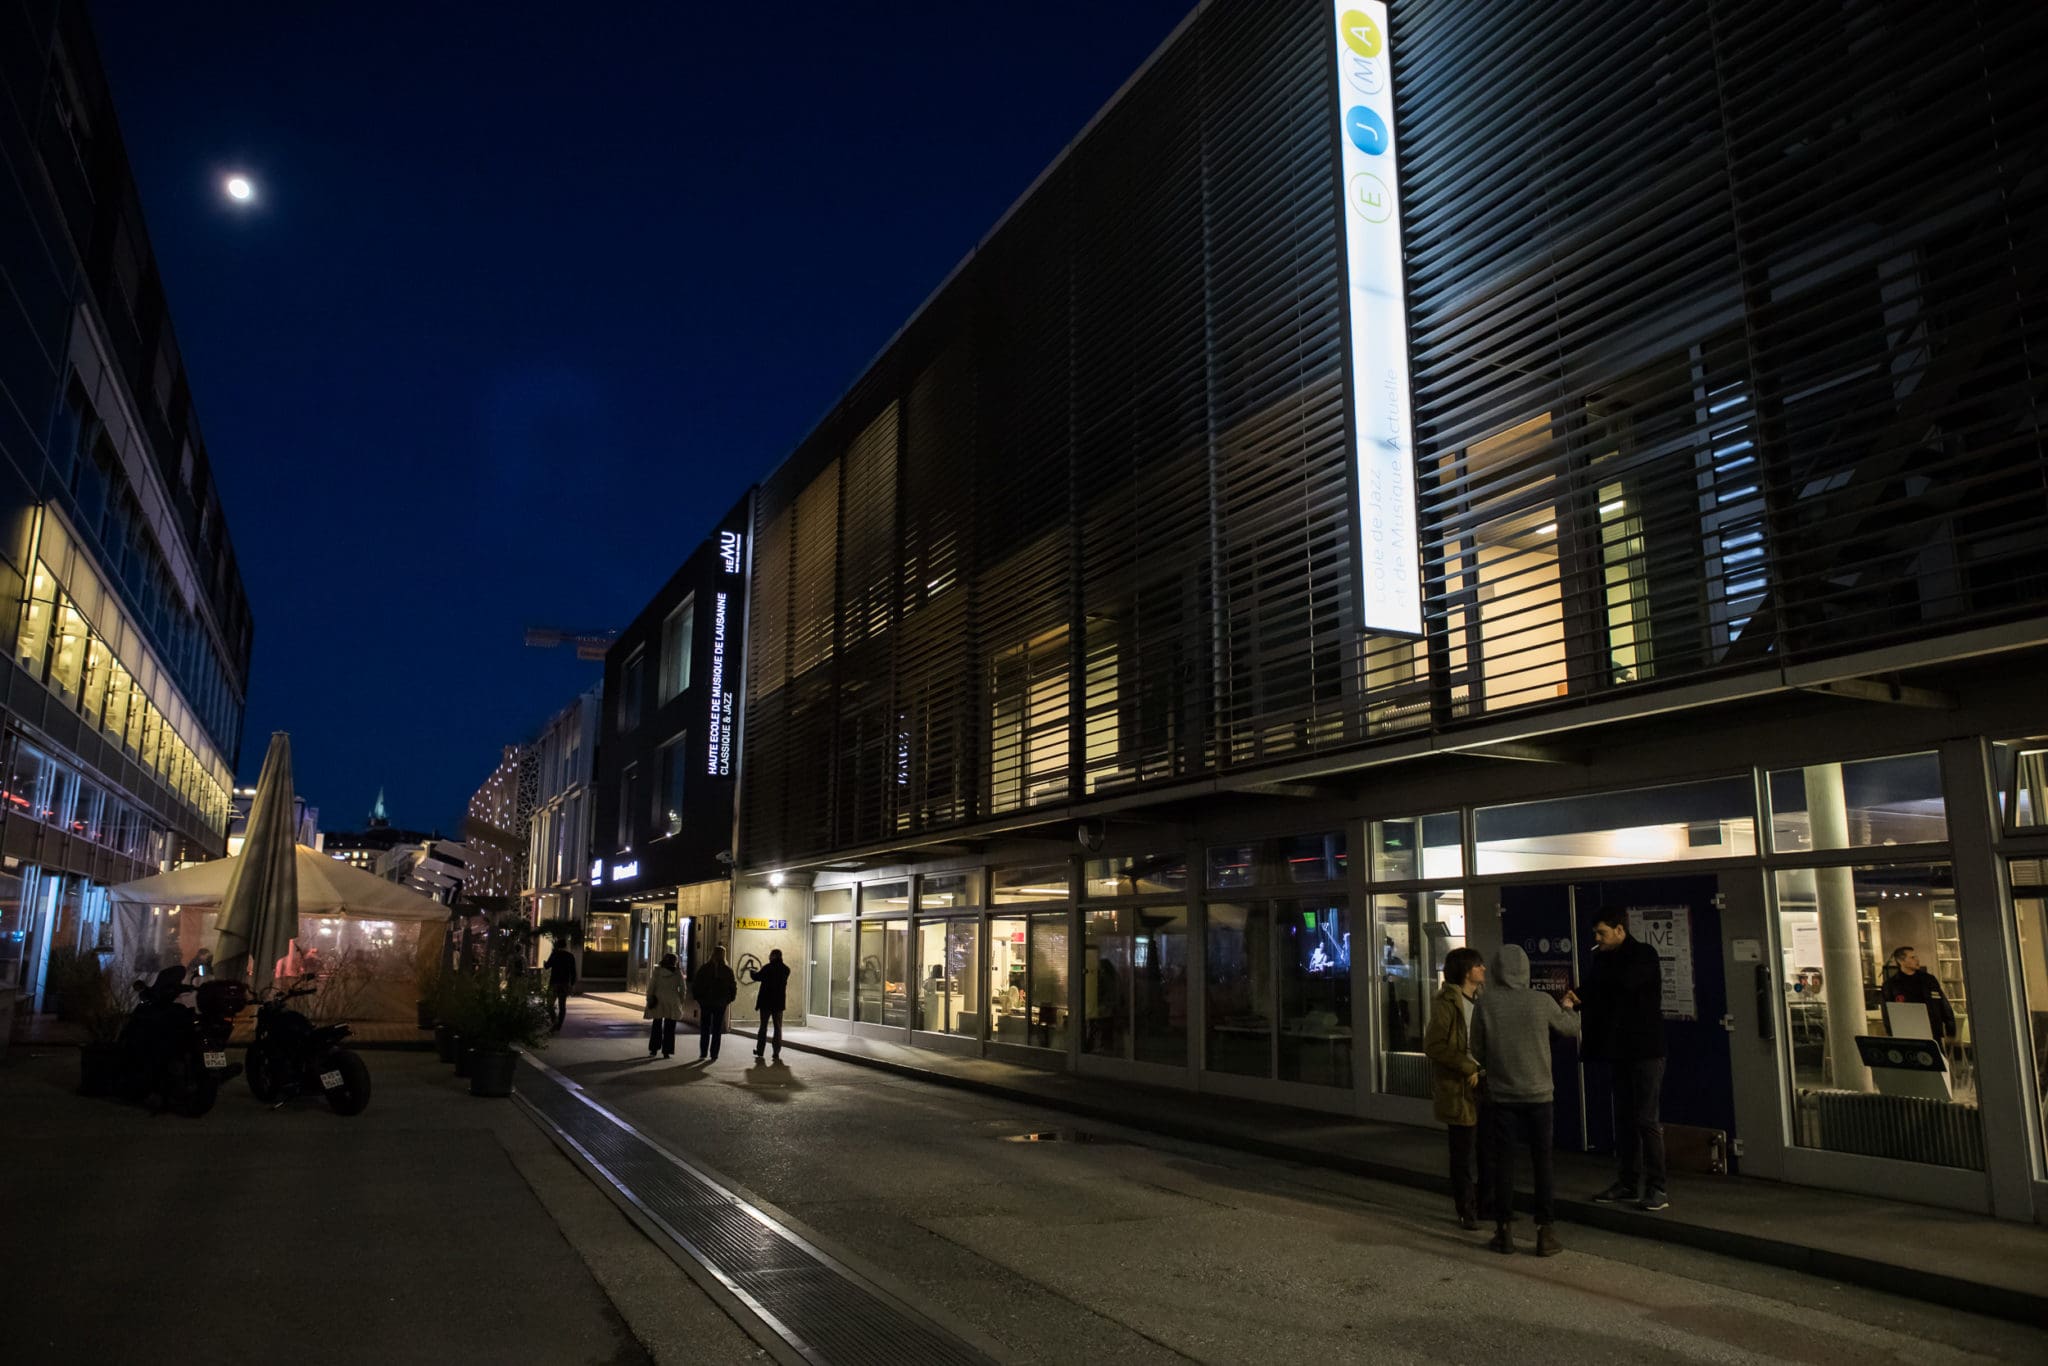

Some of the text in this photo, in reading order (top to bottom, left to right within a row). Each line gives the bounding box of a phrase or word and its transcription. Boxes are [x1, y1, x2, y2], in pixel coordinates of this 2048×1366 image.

[1383, 368, 1402, 451] Actuelle
[1367, 468, 1383, 511] Jazz
[1370, 517, 1385, 542] de
[1389, 460, 1406, 548] Musique
[1392, 556, 1407, 582] de
[708, 592, 727, 775] HAUTE ECOLE DE MUSIQUE DE LAUSANNE
[720, 692, 733, 775] CLASSIQUE & JAZZ
